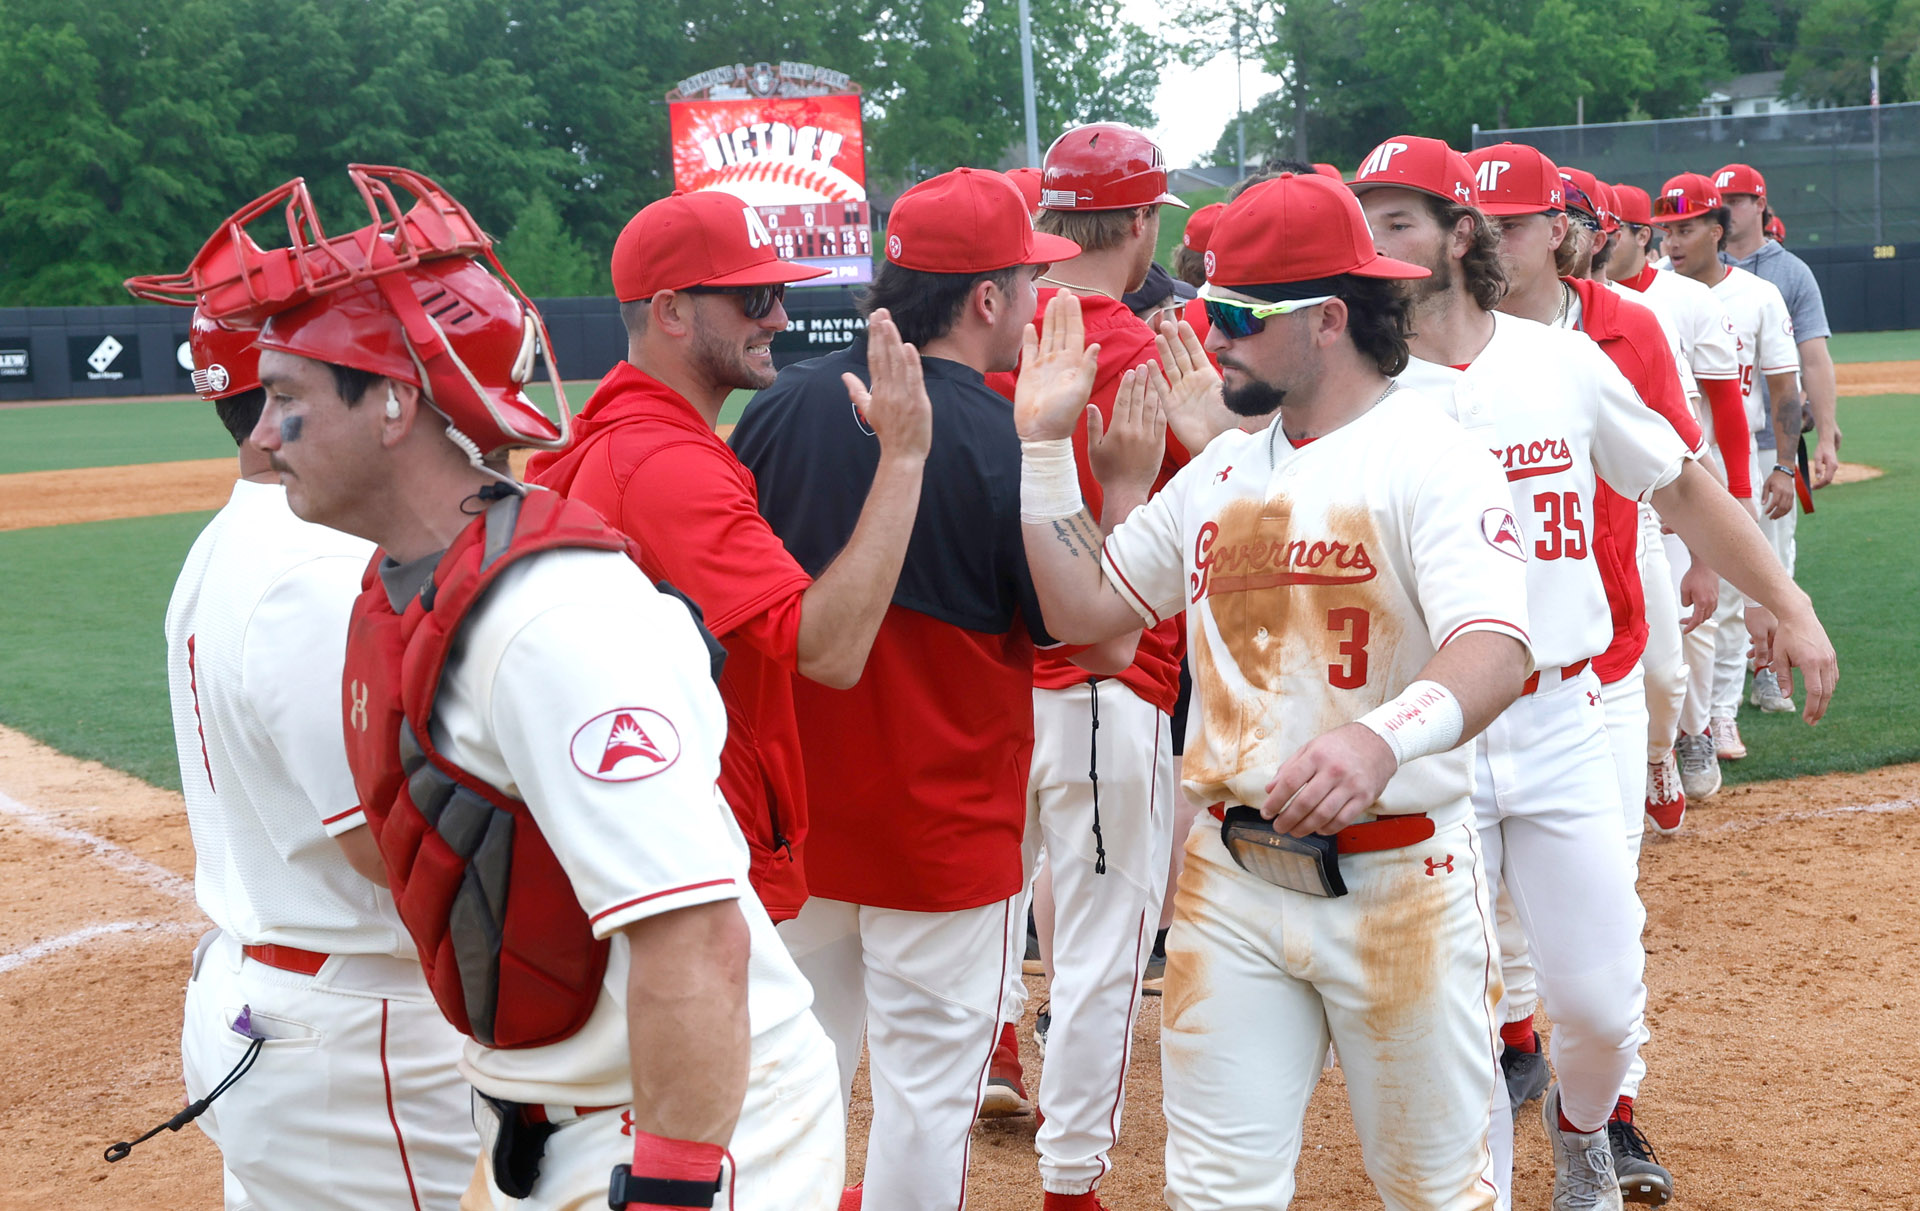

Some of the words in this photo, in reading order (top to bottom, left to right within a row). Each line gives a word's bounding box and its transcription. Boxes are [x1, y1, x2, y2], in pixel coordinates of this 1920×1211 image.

[700, 121, 843, 171] VICTORY
[1361, 143, 1408, 179] AP
[808, 331, 854, 343] FIELD
[1533, 491, 1588, 561] 35
[1191, 521, 1377, 604] Governors
[1328, 607, 1370, 690] 3
